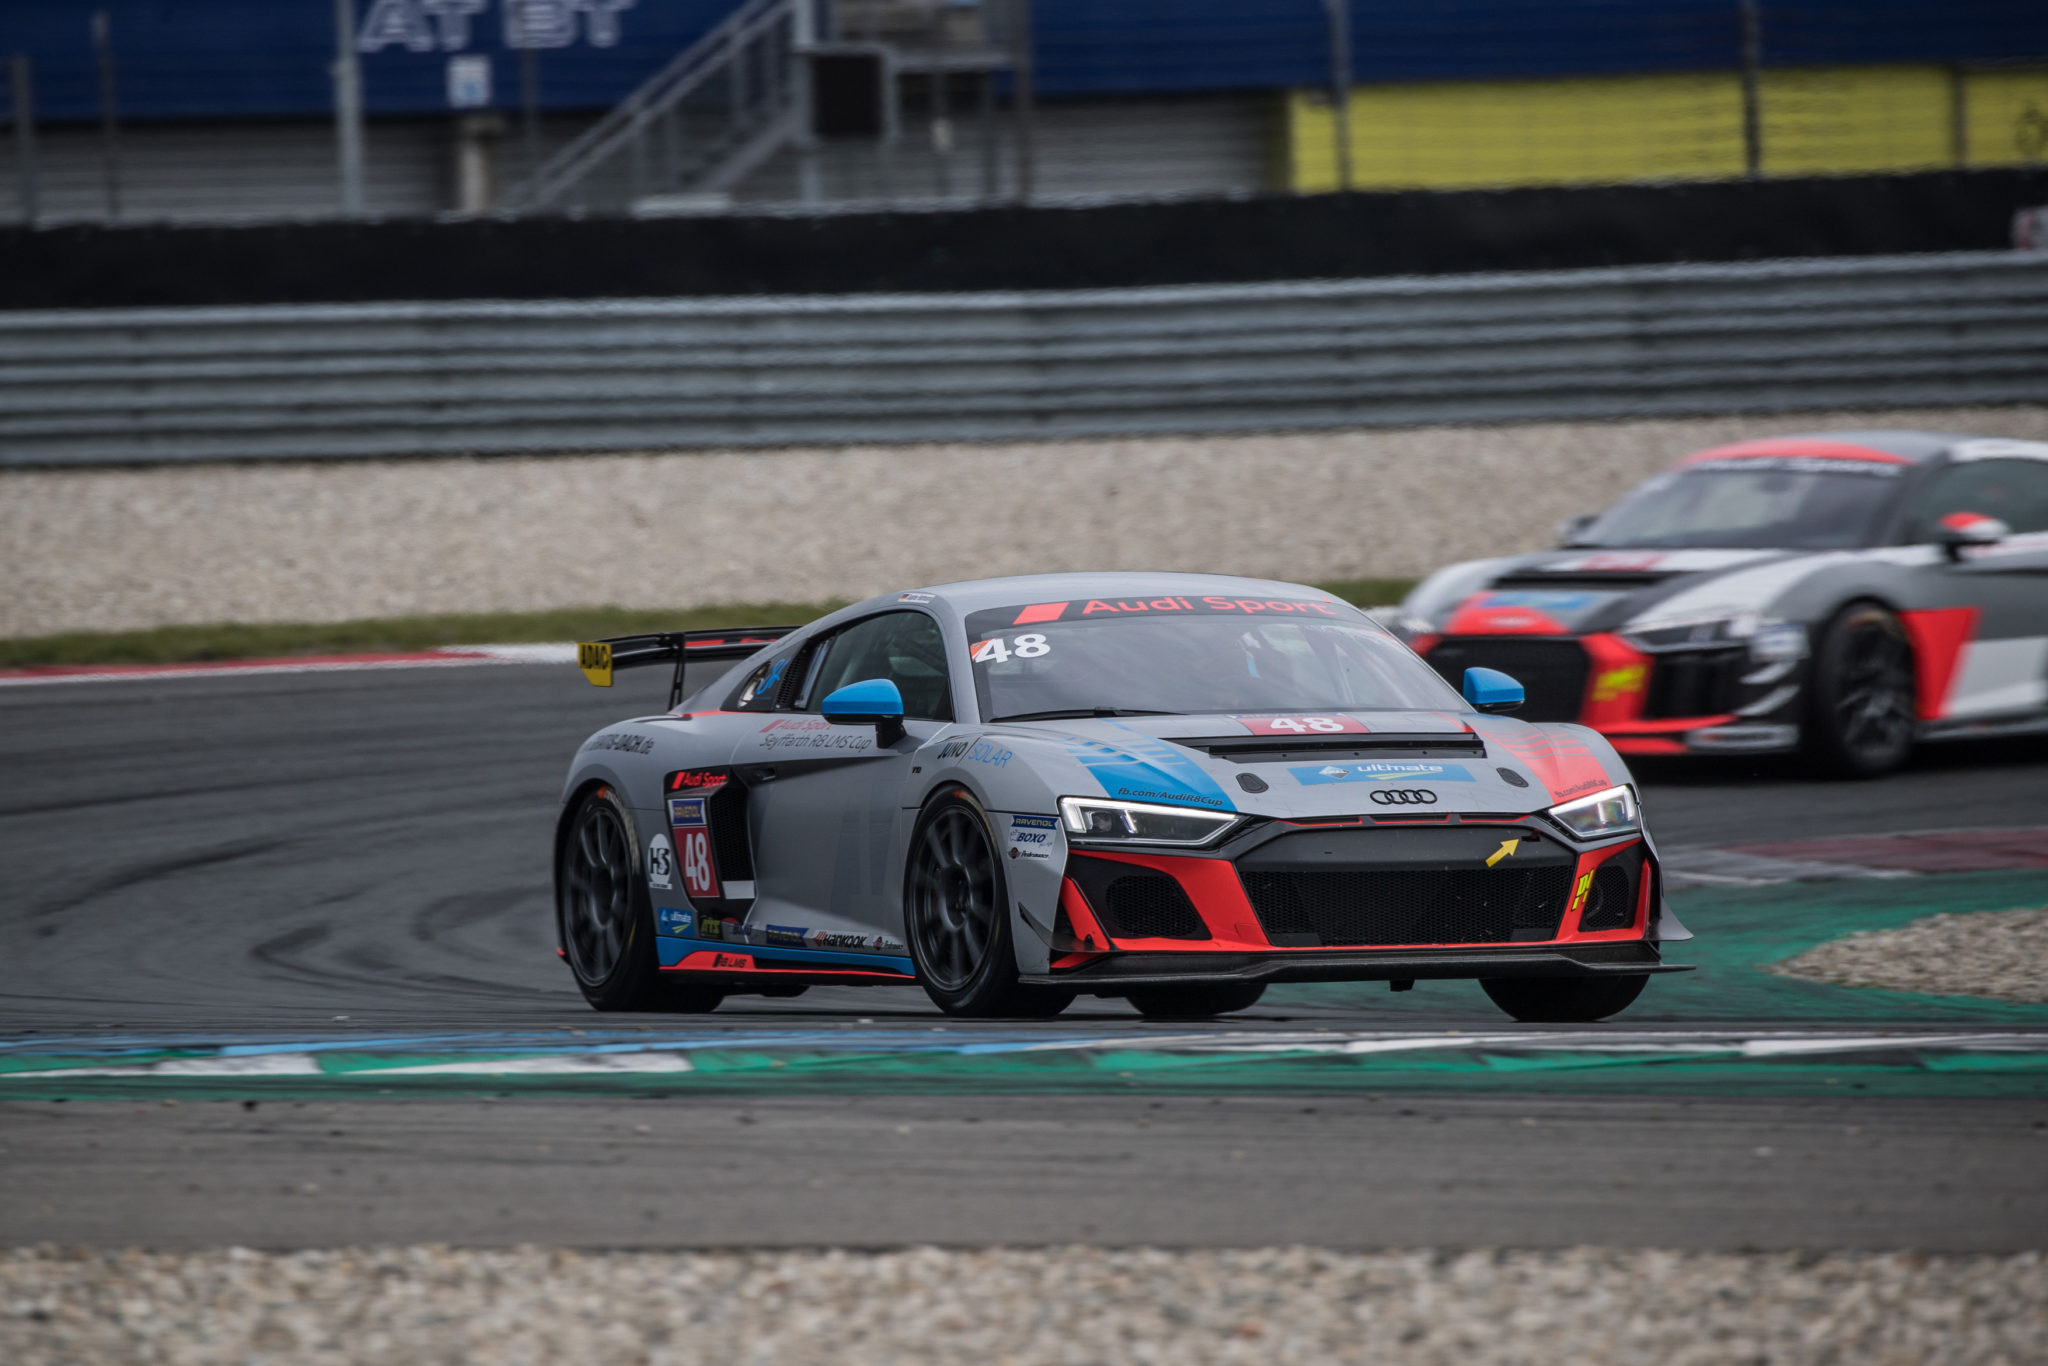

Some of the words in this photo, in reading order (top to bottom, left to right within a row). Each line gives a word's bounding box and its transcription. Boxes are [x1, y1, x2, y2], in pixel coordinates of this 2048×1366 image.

[1081, 597, 1194, 615] Audi
[1202, 596, 1337, 616] Sport
[579, 643, 609, 670] ADAC
[975, 633, 1051, 663] 48
[1269, 717, 1344, 732] 48
[759, 733, 811, 751] Seyffarth
[808, 734, 829, 748] R8
[824, 735, 853, 749] LMS
[848, 736, 873, 753] Cup
[937, 741, 968, 759] JUNO
[967, 743, 1014, 769] SOLAR
[1357, 763, 1443, 772] ultimate
[682, 771, 704, 786] Audi
[702, 771, 727, 788] Sport
[1118, 787, 1224, 807] fb.com/AudiR8Cup
[1015, 818, 1053, 827] RAVENOL
[1016, 832, 1047, 843] BOXO
[685, 832, 711, 891] 48
